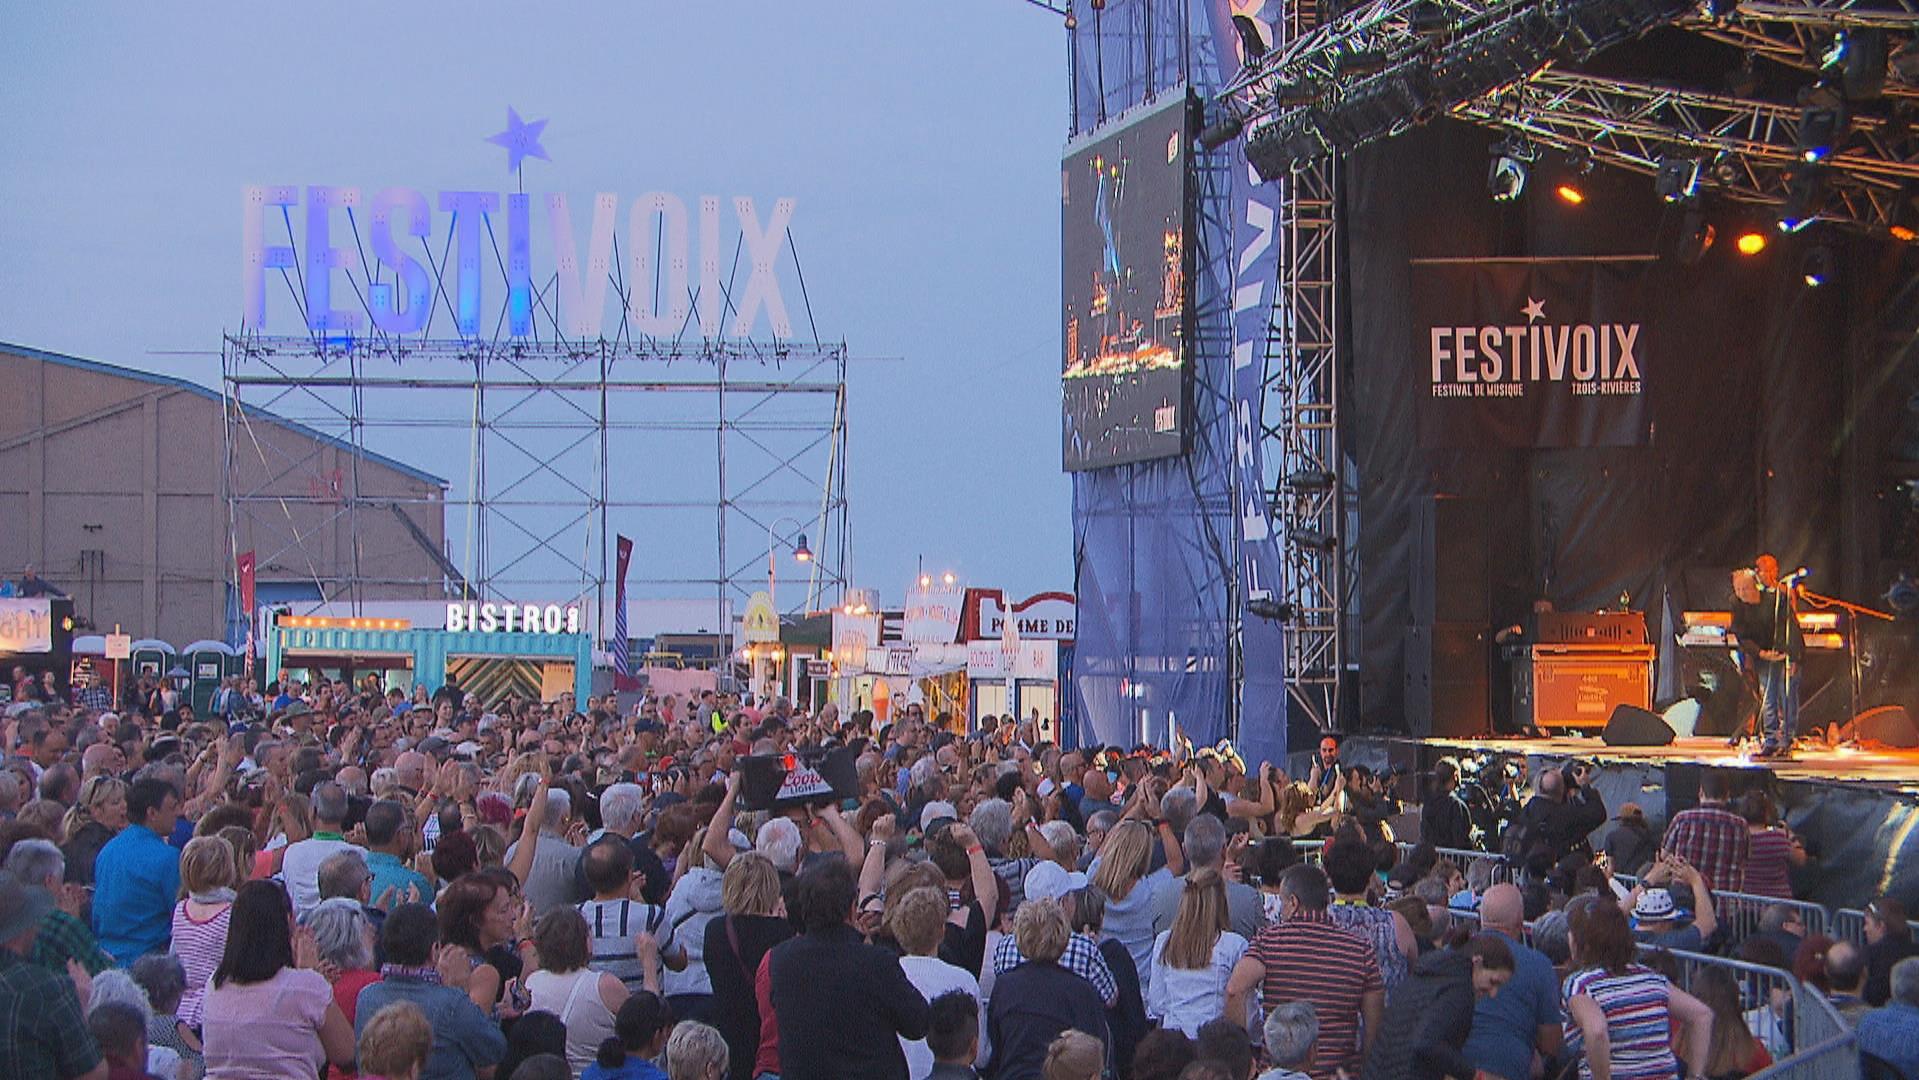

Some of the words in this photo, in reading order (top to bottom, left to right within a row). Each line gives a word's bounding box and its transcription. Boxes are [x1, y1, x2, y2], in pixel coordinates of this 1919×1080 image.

[243, 185, 797, 338] FESTIVOIX
[1431, 324, 1641, 382] FESTIVOIX
[1432, 384, 1472, 397] FESTIVAL
[1474, 384, 1485, 397] DE
[1487, 383, 1524, 397] MUSIQUE
[1572, 380, 1641, 395] TROIS-RIVIÈRES
[446, 603, 563, 634] BISTRO
[790, 781, 816, 794] LIGHT
